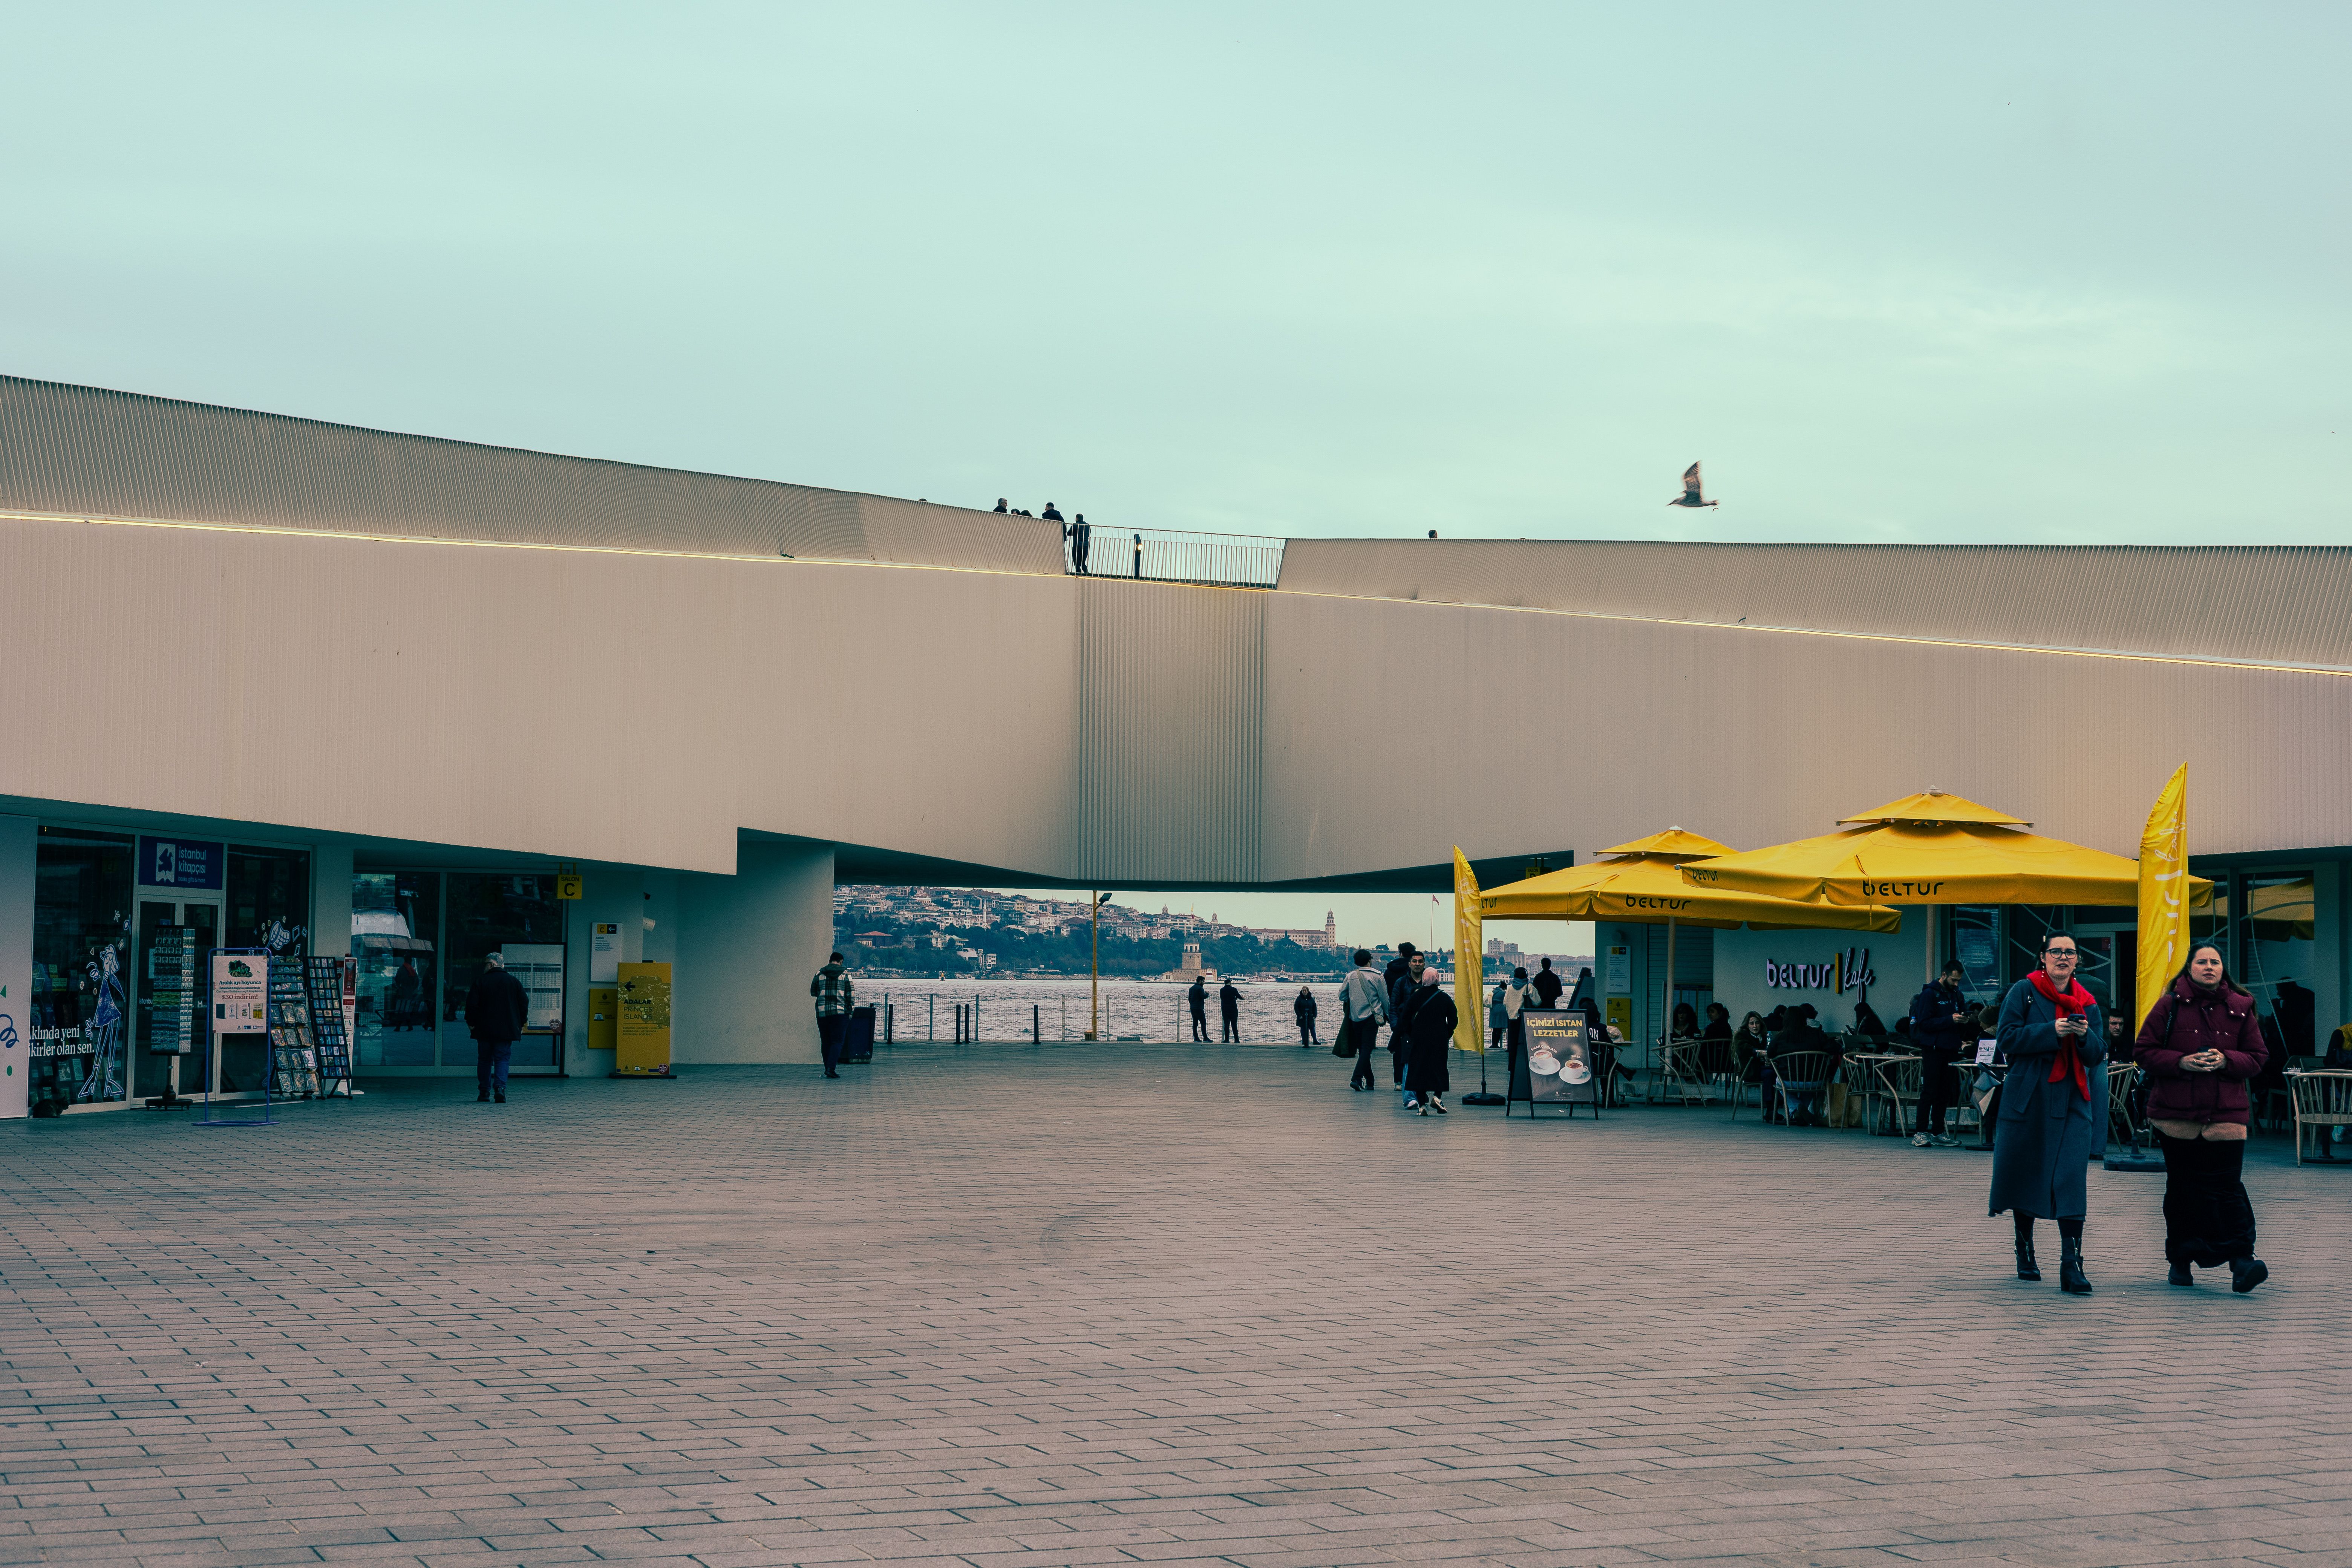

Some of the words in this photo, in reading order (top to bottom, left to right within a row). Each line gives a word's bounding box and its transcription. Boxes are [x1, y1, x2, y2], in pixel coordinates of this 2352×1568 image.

[179, 846, 207, 860] istanbul
[178, 860, 206, 874] kitapçısı
[565, 883, 575, 896] C
[1844, 947, 1873, 1003] kafe
[1527, 1018, 1555, 1028] İÇİNİZİ
[29, 1025, 60, 1039] klında
[60, 1024, 80, 1041] yeni
[29, 1042, 55, 1057] ikirler
[57, 1041, 76, 1055] olan
[77, 1043, 95, 1054] sen.
